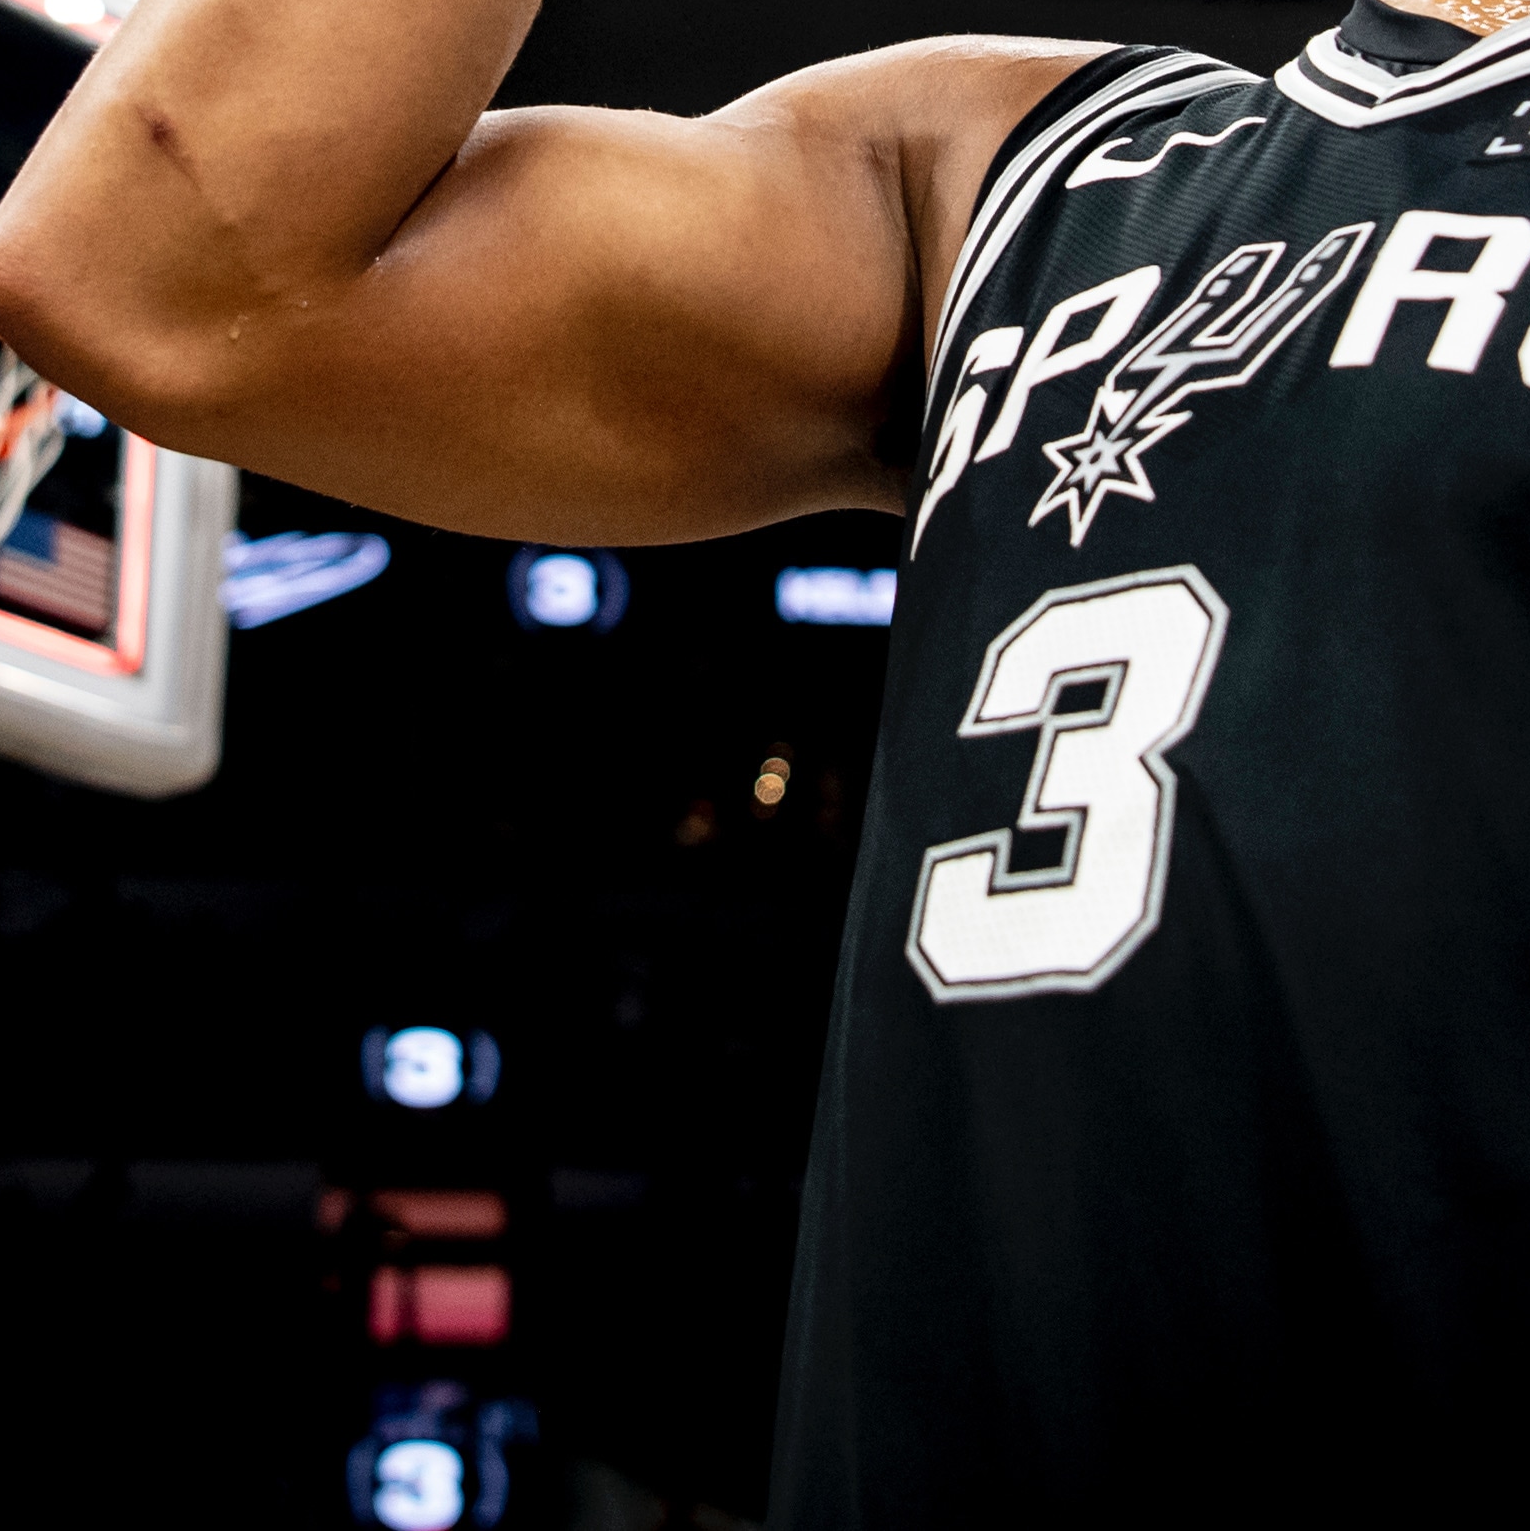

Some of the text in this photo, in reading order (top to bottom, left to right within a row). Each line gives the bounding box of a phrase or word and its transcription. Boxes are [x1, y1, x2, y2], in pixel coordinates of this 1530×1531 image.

[905, 563, 1230, 1004] 3
[383, 1026, 464, 1109] 3
[372, 1438, 466, 1531] 3
